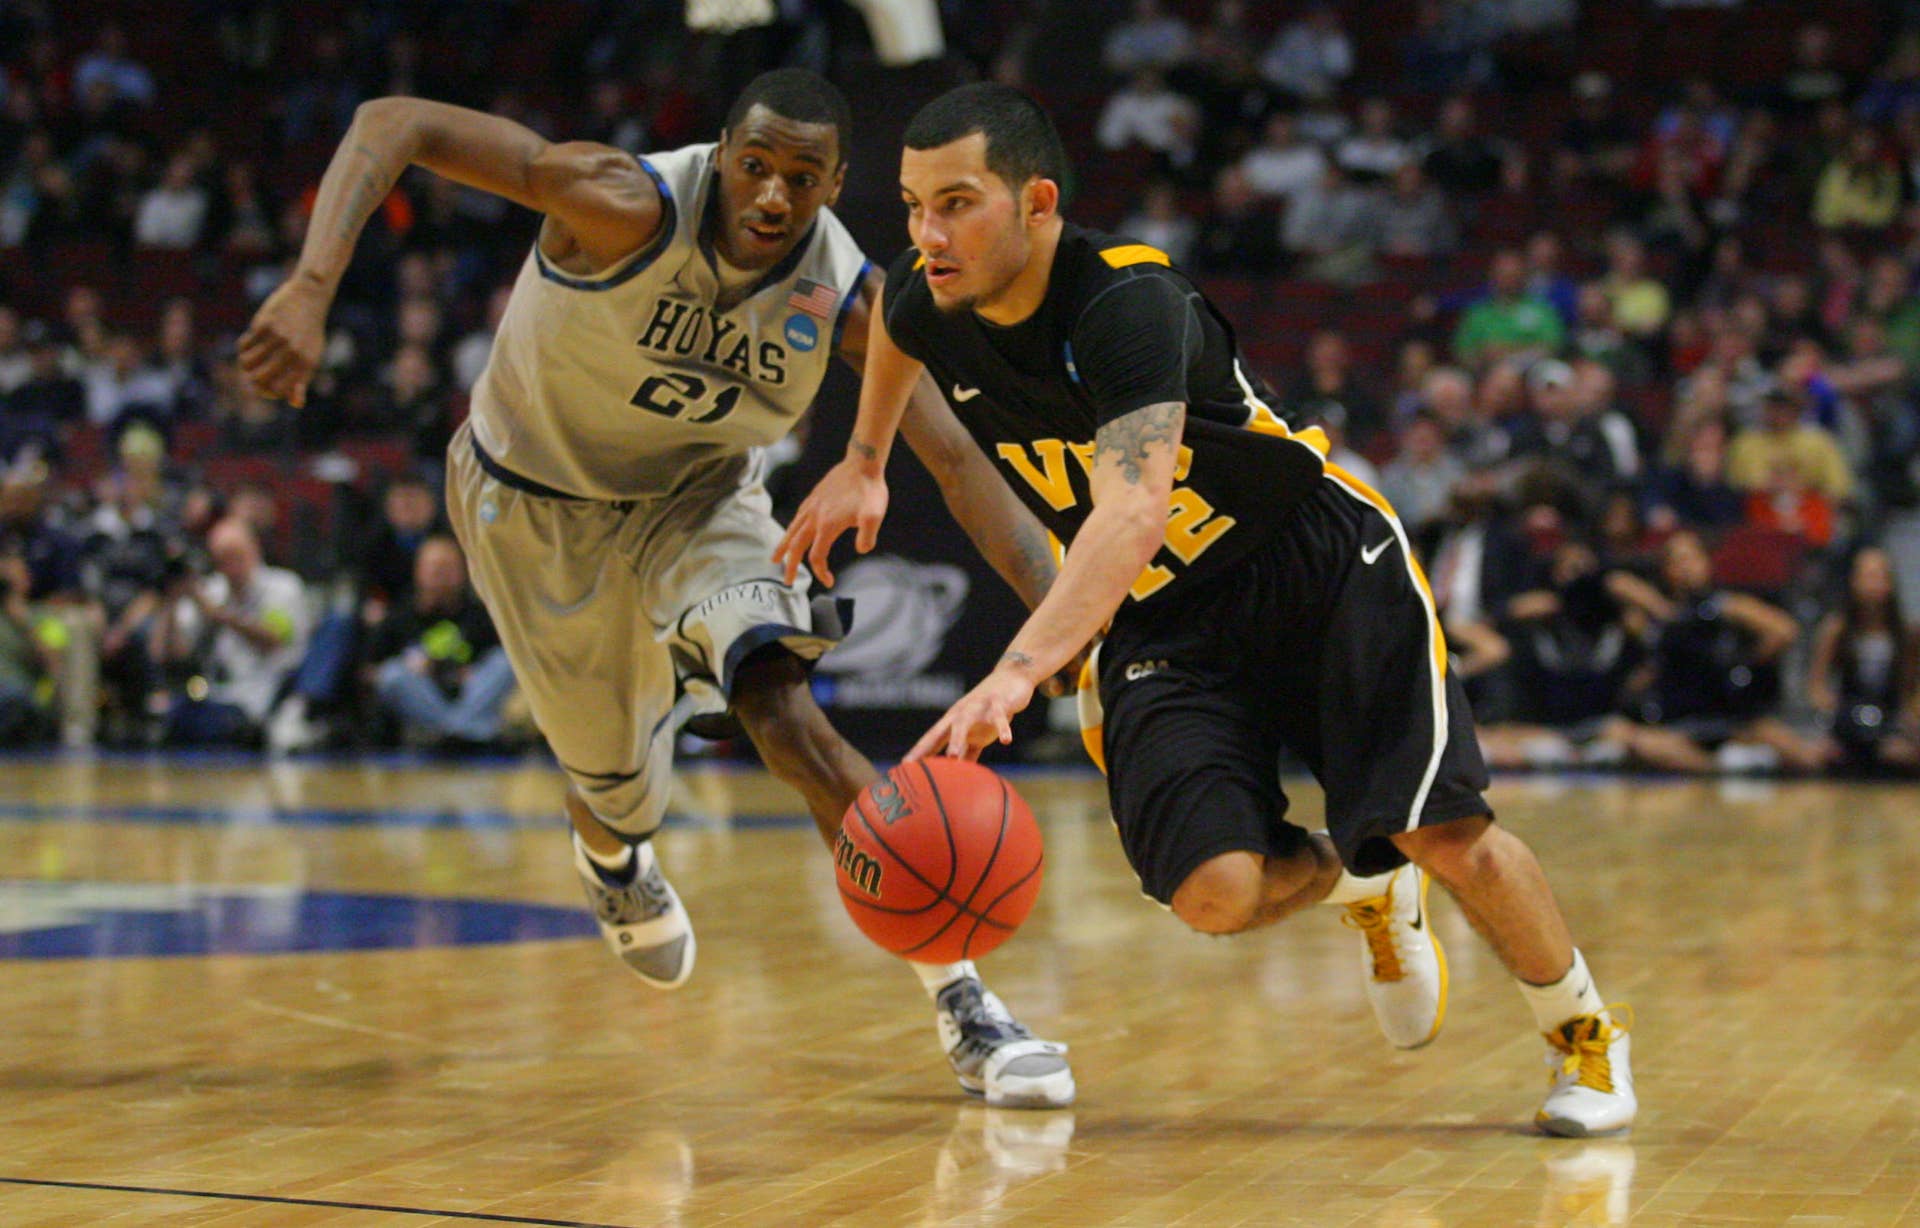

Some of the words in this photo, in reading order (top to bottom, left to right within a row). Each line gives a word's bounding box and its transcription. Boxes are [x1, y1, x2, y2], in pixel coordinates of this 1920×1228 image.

[638, 299, 786, 384] HOYAS
[630, 372, 741, 423] 21
[871, 775, 913, 825] ON
